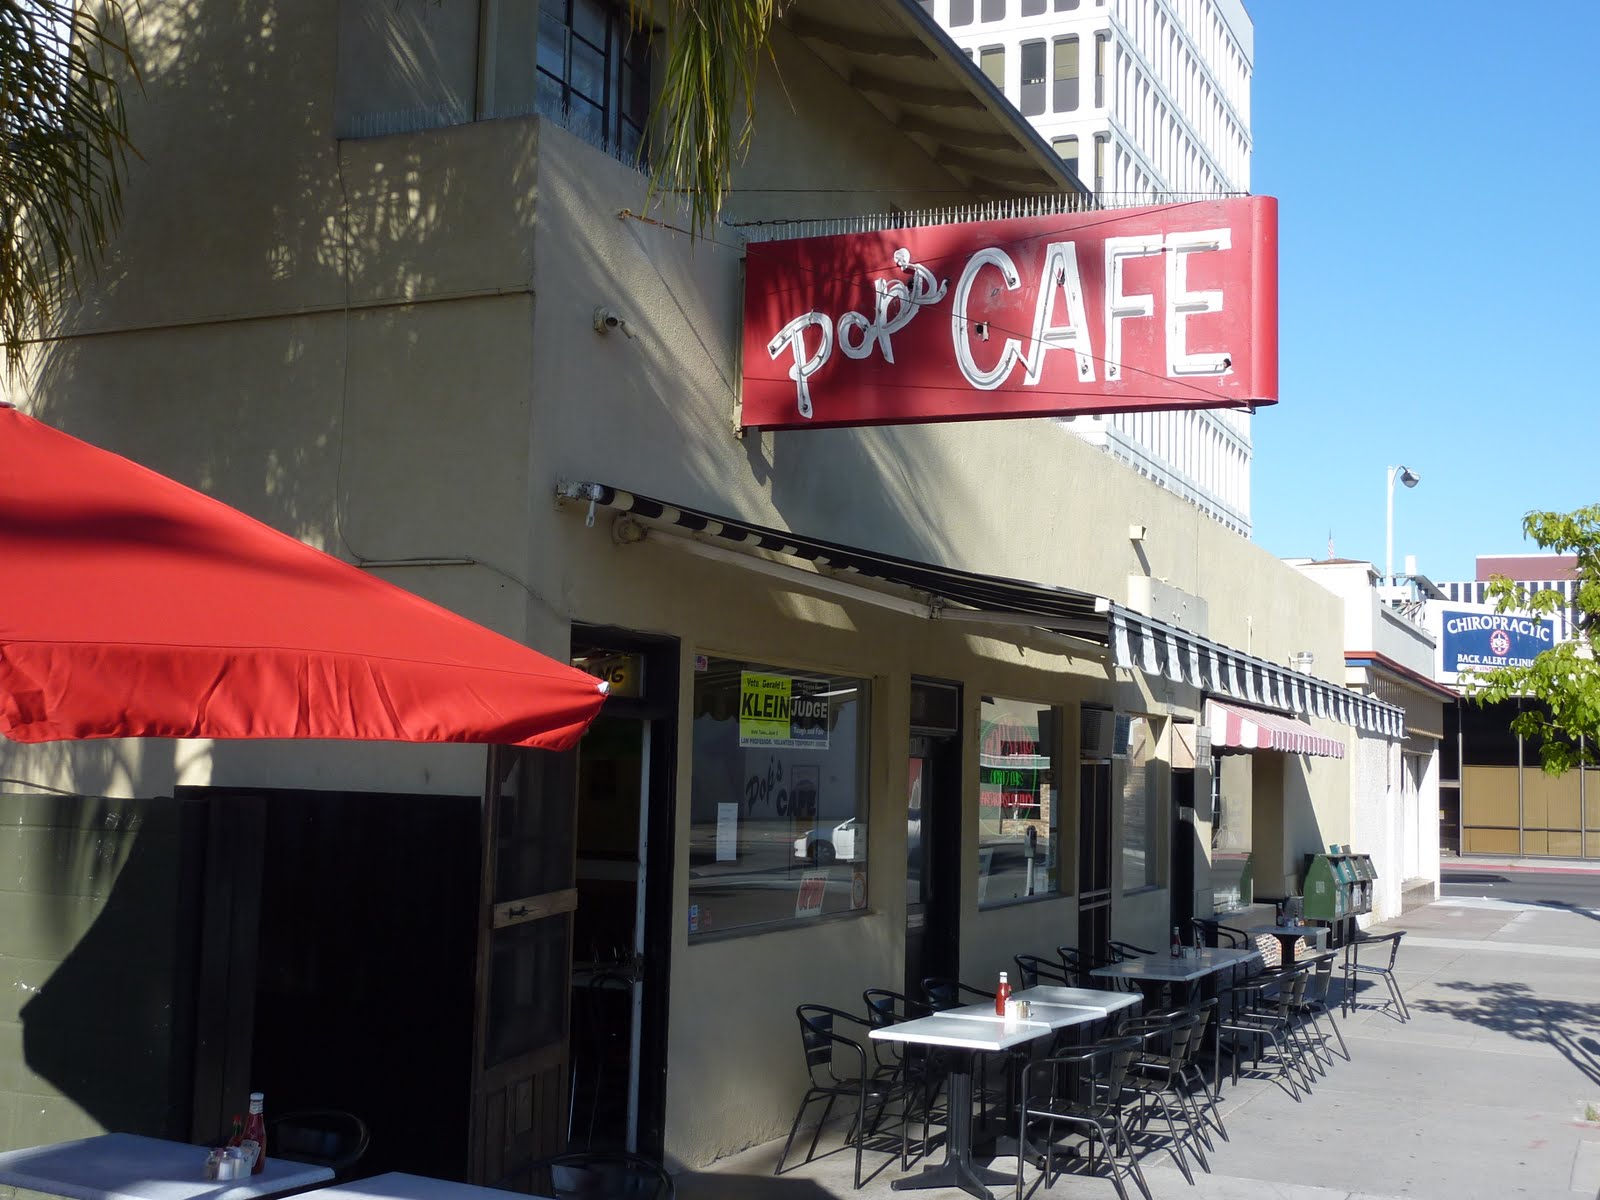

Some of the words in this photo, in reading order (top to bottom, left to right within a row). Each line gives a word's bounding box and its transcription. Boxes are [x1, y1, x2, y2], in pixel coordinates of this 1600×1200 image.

[952, 228, 1233, 390] CAFE
[1447, 615, 1550, 641] CHIROPRACTIC
[1457, 653, 1480, 664] BACK
[1482, 655, 1507, 665] ALERT
[747, 677, 759, 687] Vote
[762, 679, 780, 689] Gerald
[742, 692, 790, 718] KLEIN
[791, 700, 828, 718] JUDGE
[793, 726, 806, 735] Tough
[806, 727, 815, 735] and
[745, 755, 784, 817] Pop's
[776, 787, 817, 817] CAFE
